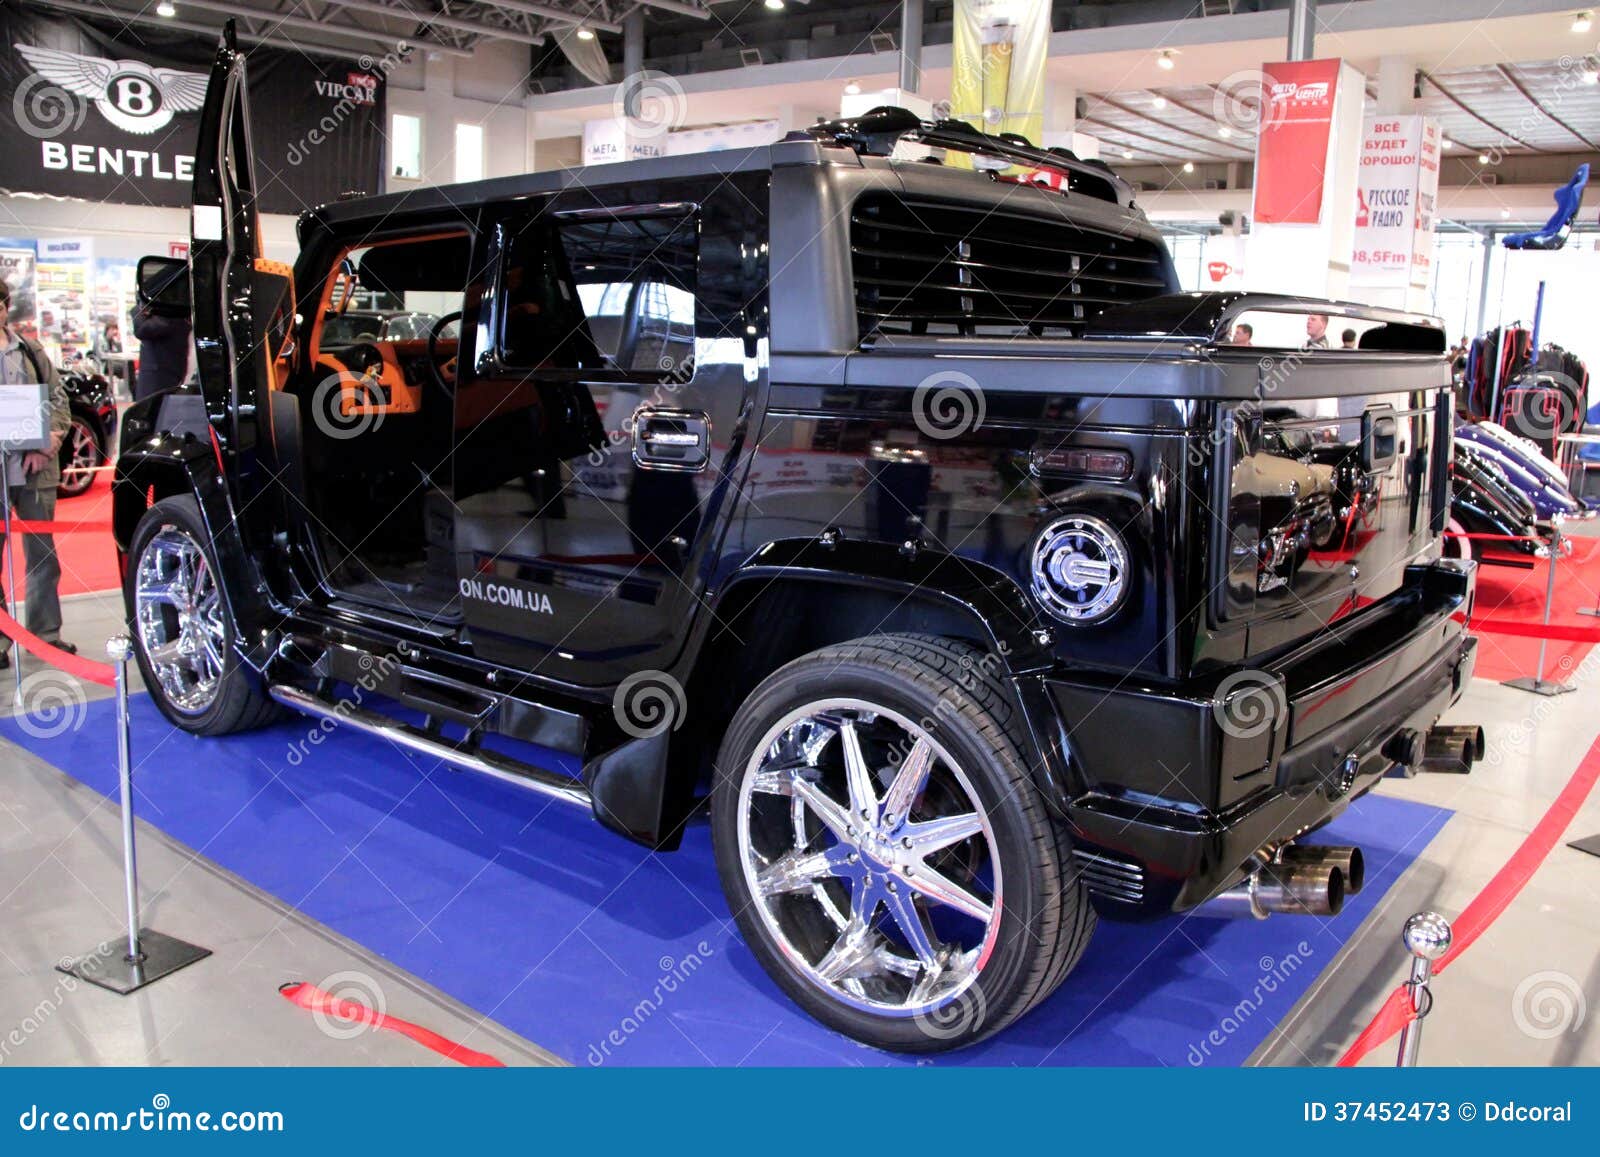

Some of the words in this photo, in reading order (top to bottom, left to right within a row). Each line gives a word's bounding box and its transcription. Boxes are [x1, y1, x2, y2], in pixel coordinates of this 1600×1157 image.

[315, 80, 376, 104] VIPCAR
[1374, 121, 1401, 134] ВСЁ
[1364, 139, 1408, 152] БУДЕТ
[41, 140, 196, 181] BENTLE
[1359, 155, 1416, 167] ОРОШО!
[1368, 188, 1410, 207] РУССКОЕ
[1371, 209, 1403, 228] РАДИО
[460, 578, 554, 615] ON.COM.UA
